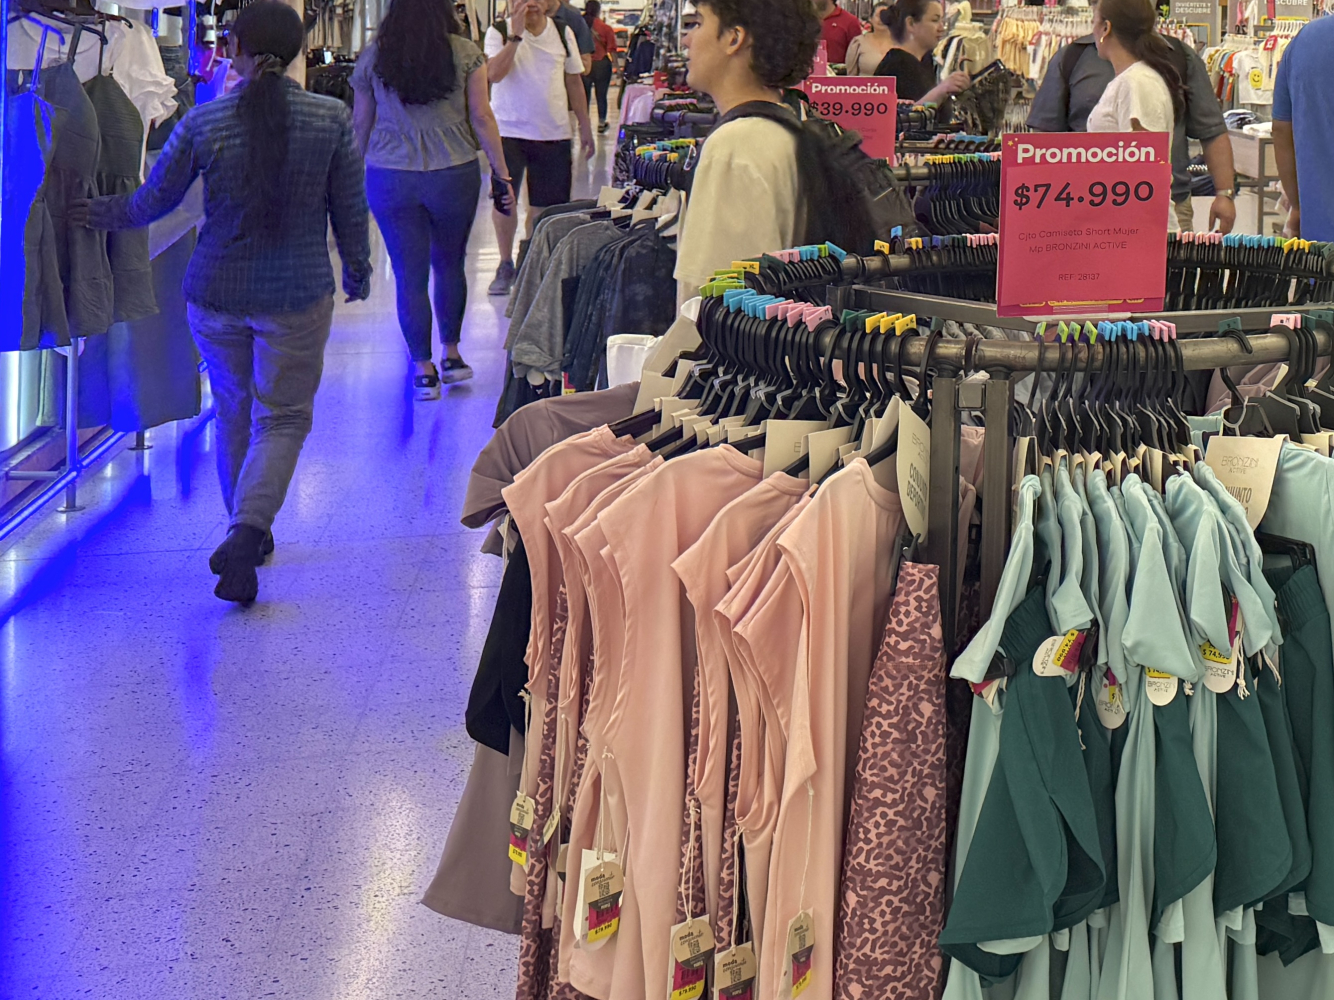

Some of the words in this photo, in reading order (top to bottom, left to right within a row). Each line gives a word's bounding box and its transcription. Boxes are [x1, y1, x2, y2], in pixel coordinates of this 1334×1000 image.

[811, 83, 888, 95] Promoción
[1017, 141, 1155, 164] Promoción
[1013, 181, 1154, 211] $74.990
[1038, 229, 1083, 239] Camiseta
[1085, 227, 1111, 236] Short
[1113, 227, 1140, 238] Mujer
[1045, 243, 1091, 252] BRONZINI
[1093, 241, 1128, 250] ACTIVE
